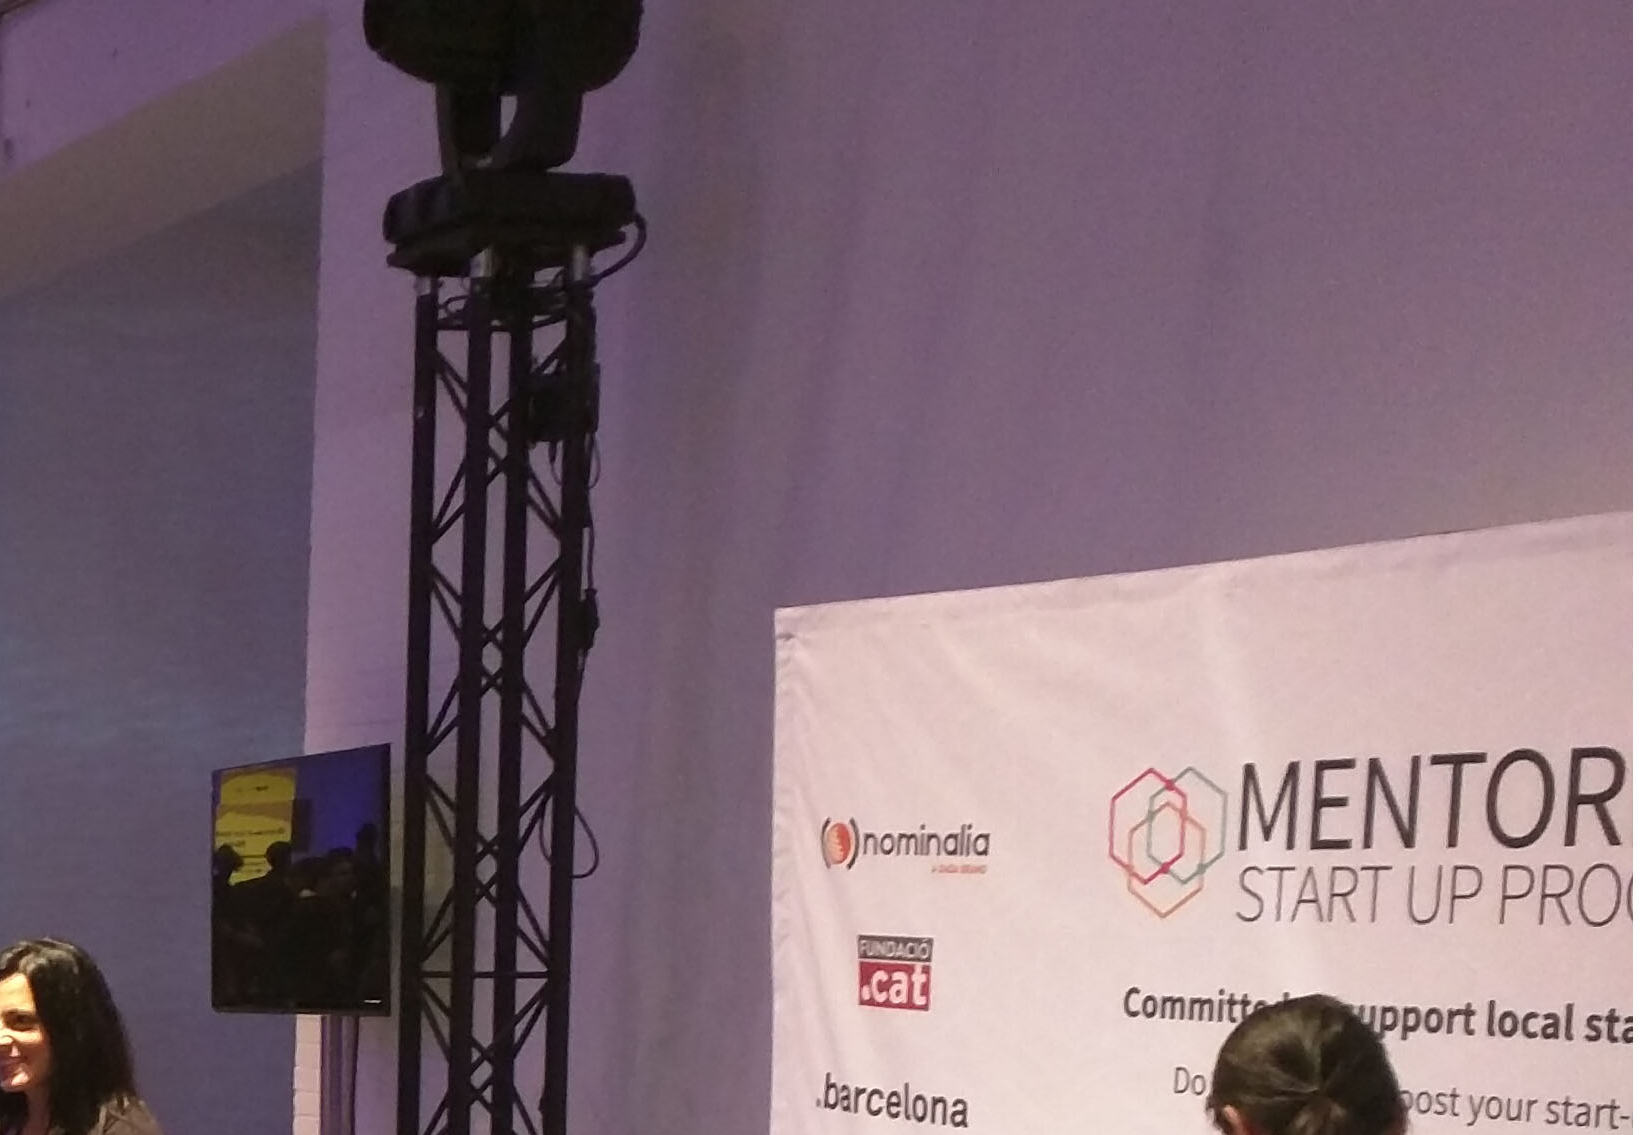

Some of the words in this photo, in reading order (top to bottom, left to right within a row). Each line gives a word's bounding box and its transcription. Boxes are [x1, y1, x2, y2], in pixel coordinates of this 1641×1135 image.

[1238, 746, 1626, 851] MENTOR
[862, 823, 991, 857] nominalia
[1235, 865, 1393, 923] START
[1407, 864, 1483, 925] UP
[1499, 863, 1633, 927] PRO
[859, 938, 931, 960] FUNDACIÓ
[861, 964, 928, 1006] .cat
[1352, 1002, 1477, 1041] upport
[1487, 1000, 1575, 1041] local
[815, 1072, 969, 1128] .barcelona
[1173, 1066, 1207, 1096] Do
[1466, 1093, 1538, 1127] your
